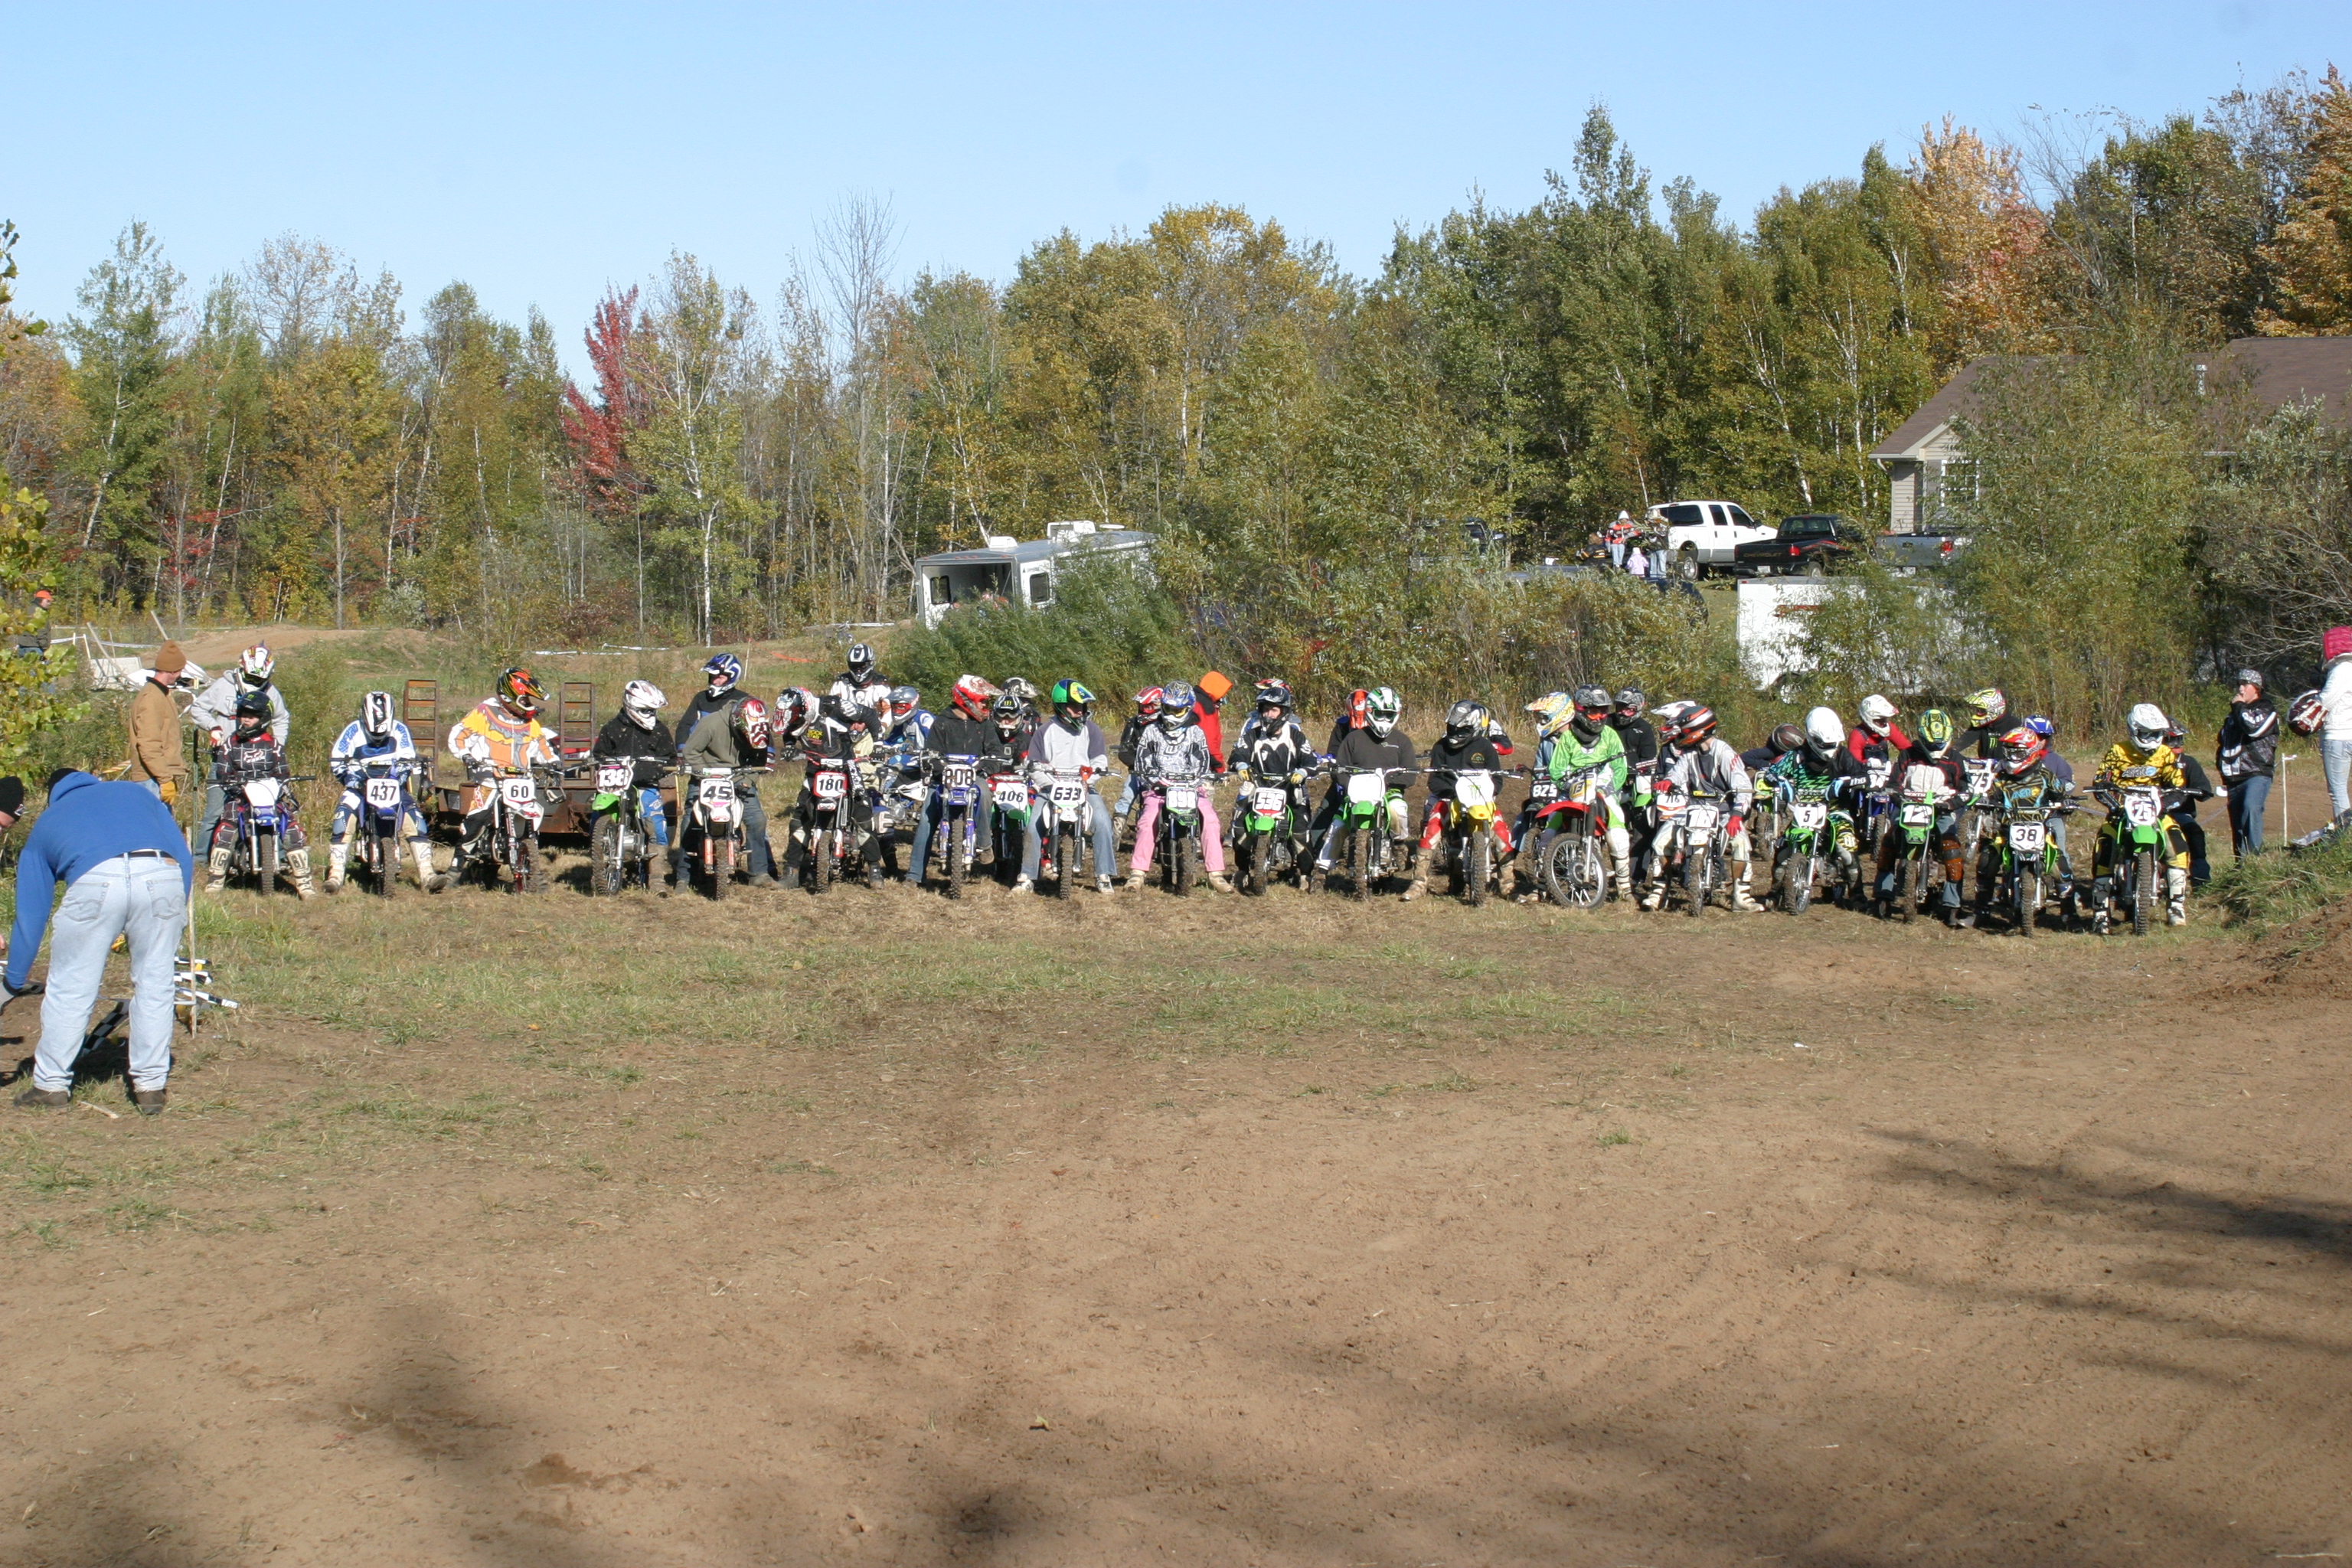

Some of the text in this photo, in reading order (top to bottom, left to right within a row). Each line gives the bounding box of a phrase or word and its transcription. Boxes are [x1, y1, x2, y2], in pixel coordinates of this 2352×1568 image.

[511, 785, 528, 798] 60
[818, 779, 844, 792] 180
[371, 785, 397, 801] 437
[703, 786, 733, 800] 45
[998, 791, 1024, 802] 406
[1054, 787, 1082, 801] 633
[1168, 790, 1196, 808] 898
[1256, 792, 1284, 811] 536
[1803, 810, 1811, 822] 5
[1903, 805, 1932, 823] 12
[2015, 828, 2037, 841] 38
